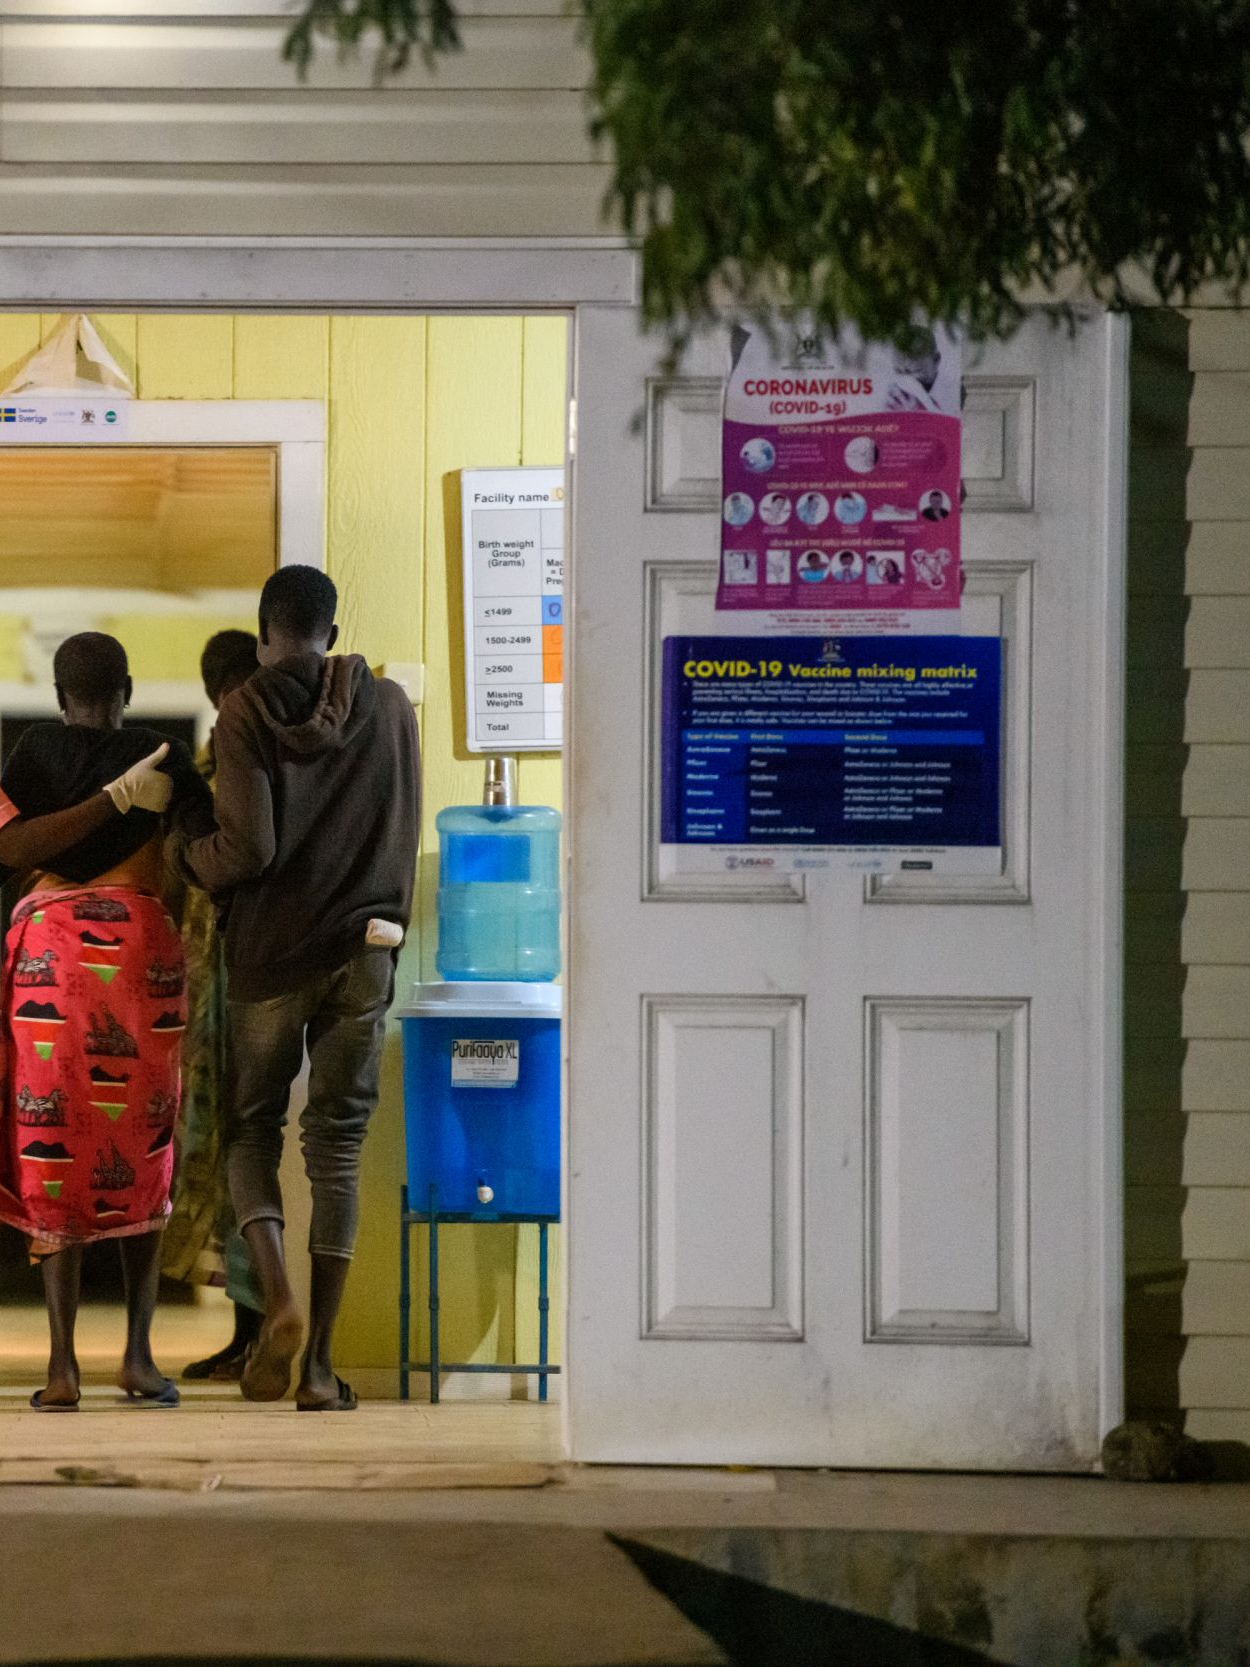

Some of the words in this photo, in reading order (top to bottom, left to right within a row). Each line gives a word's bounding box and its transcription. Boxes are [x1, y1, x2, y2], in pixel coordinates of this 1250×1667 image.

[744, 378, 872, 396] CORONAVIRUS
[770, 400, 846, 416] (COVID-19)
[18, 414, 48, 424] Sverige
[474, 493, 515, 504] Facility
[518, 494, 549, 502] name
[478, 540, 501, 549] Birth
[503, 540, 534, 550] weight
[492, 550, 521, 559] Group
[488, 558, 526, 568] (Grams)
[486, 636, 532, 645] 1500-2499
[684, 660, 783, 678] COVID-19
[789, 663, 852, 678] Vaccine
[857, 663, 916, 681] mixing
[921, 664, 977, 678] matrix
[486, 691, 523, 700] Missing
[486, 700, 524, 708] Weights
[486, 723, 510, 732] Total
[505, 1042, 518, 1059] XL
